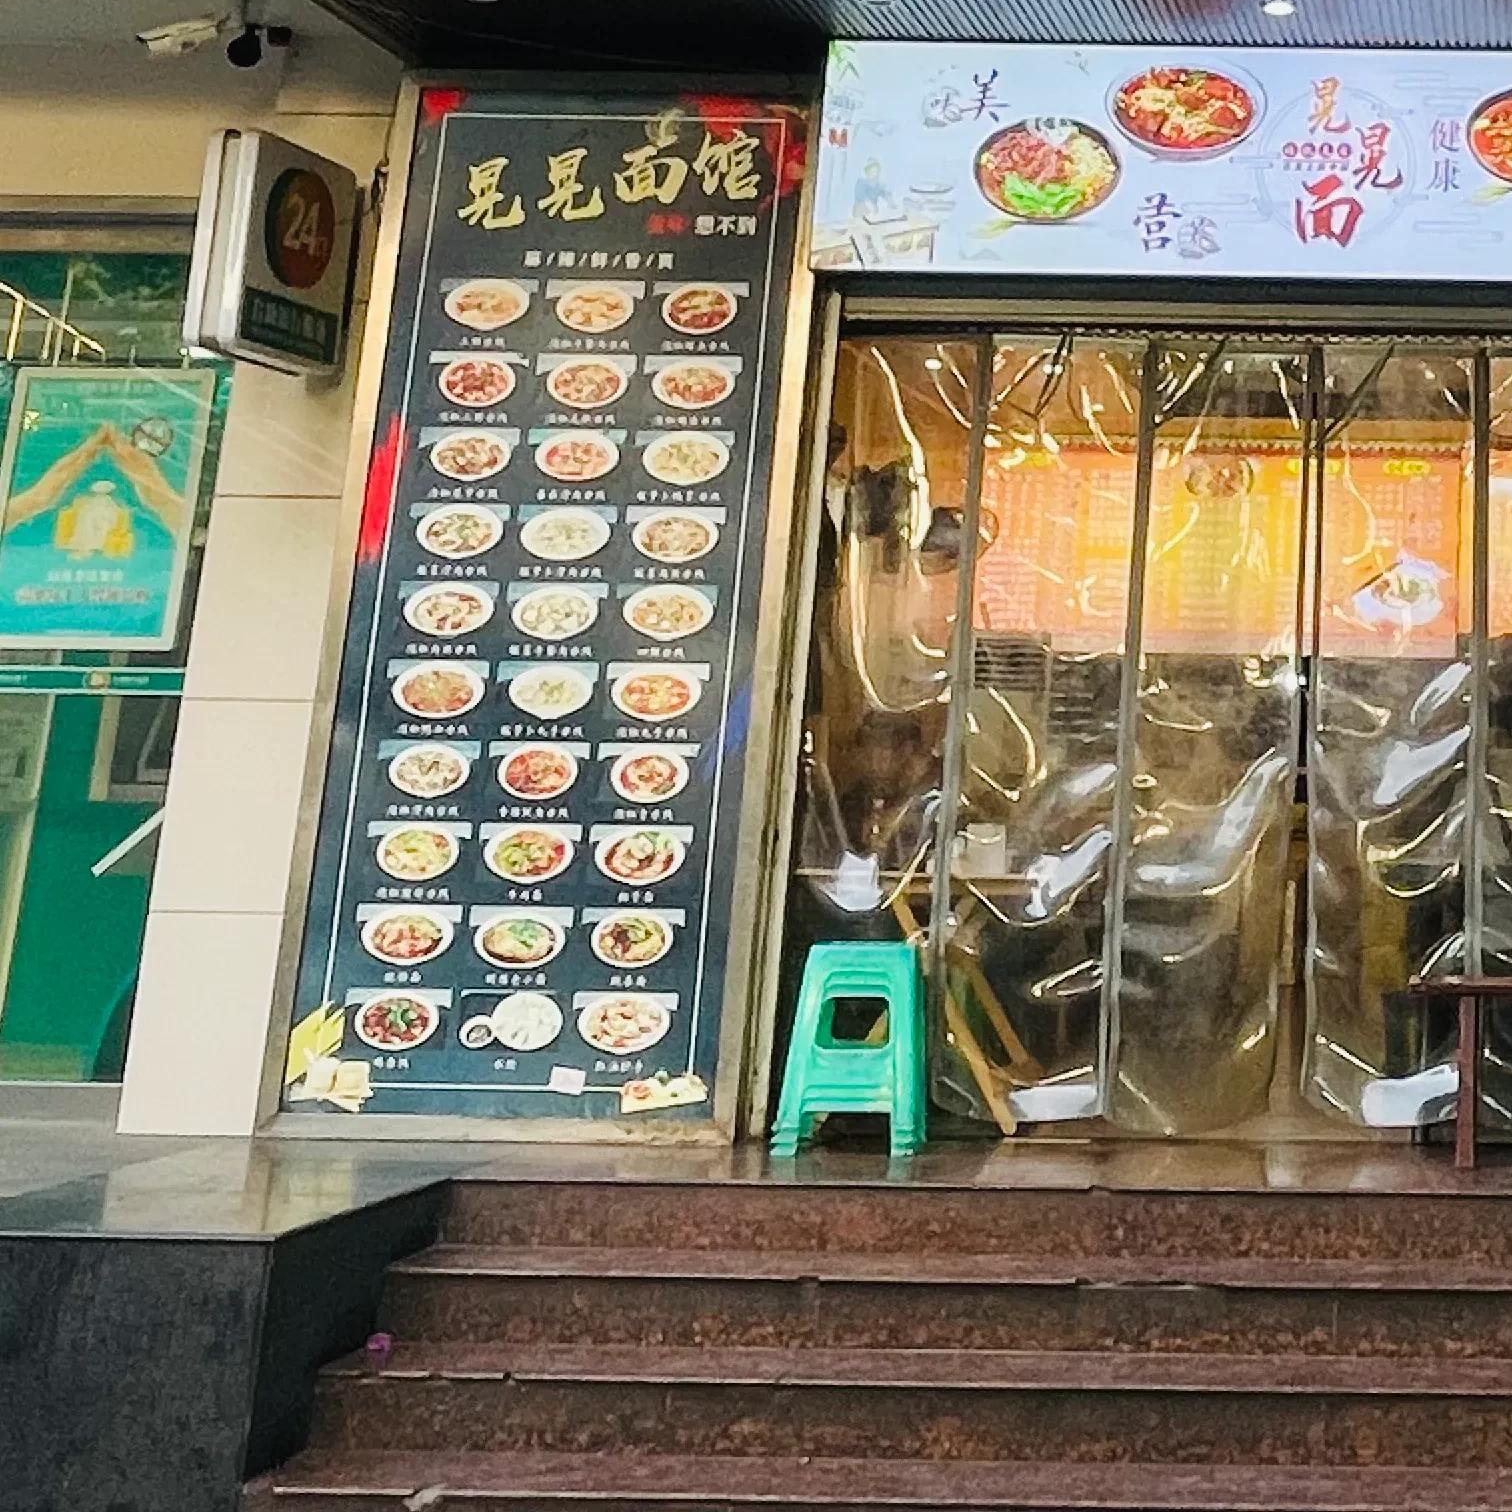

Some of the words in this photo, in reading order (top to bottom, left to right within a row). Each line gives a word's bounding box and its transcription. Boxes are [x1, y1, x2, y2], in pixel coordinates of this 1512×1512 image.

[457, 128, 762, 230] 晃晃面馆
[1428, 119, 1462, 194] 健康
